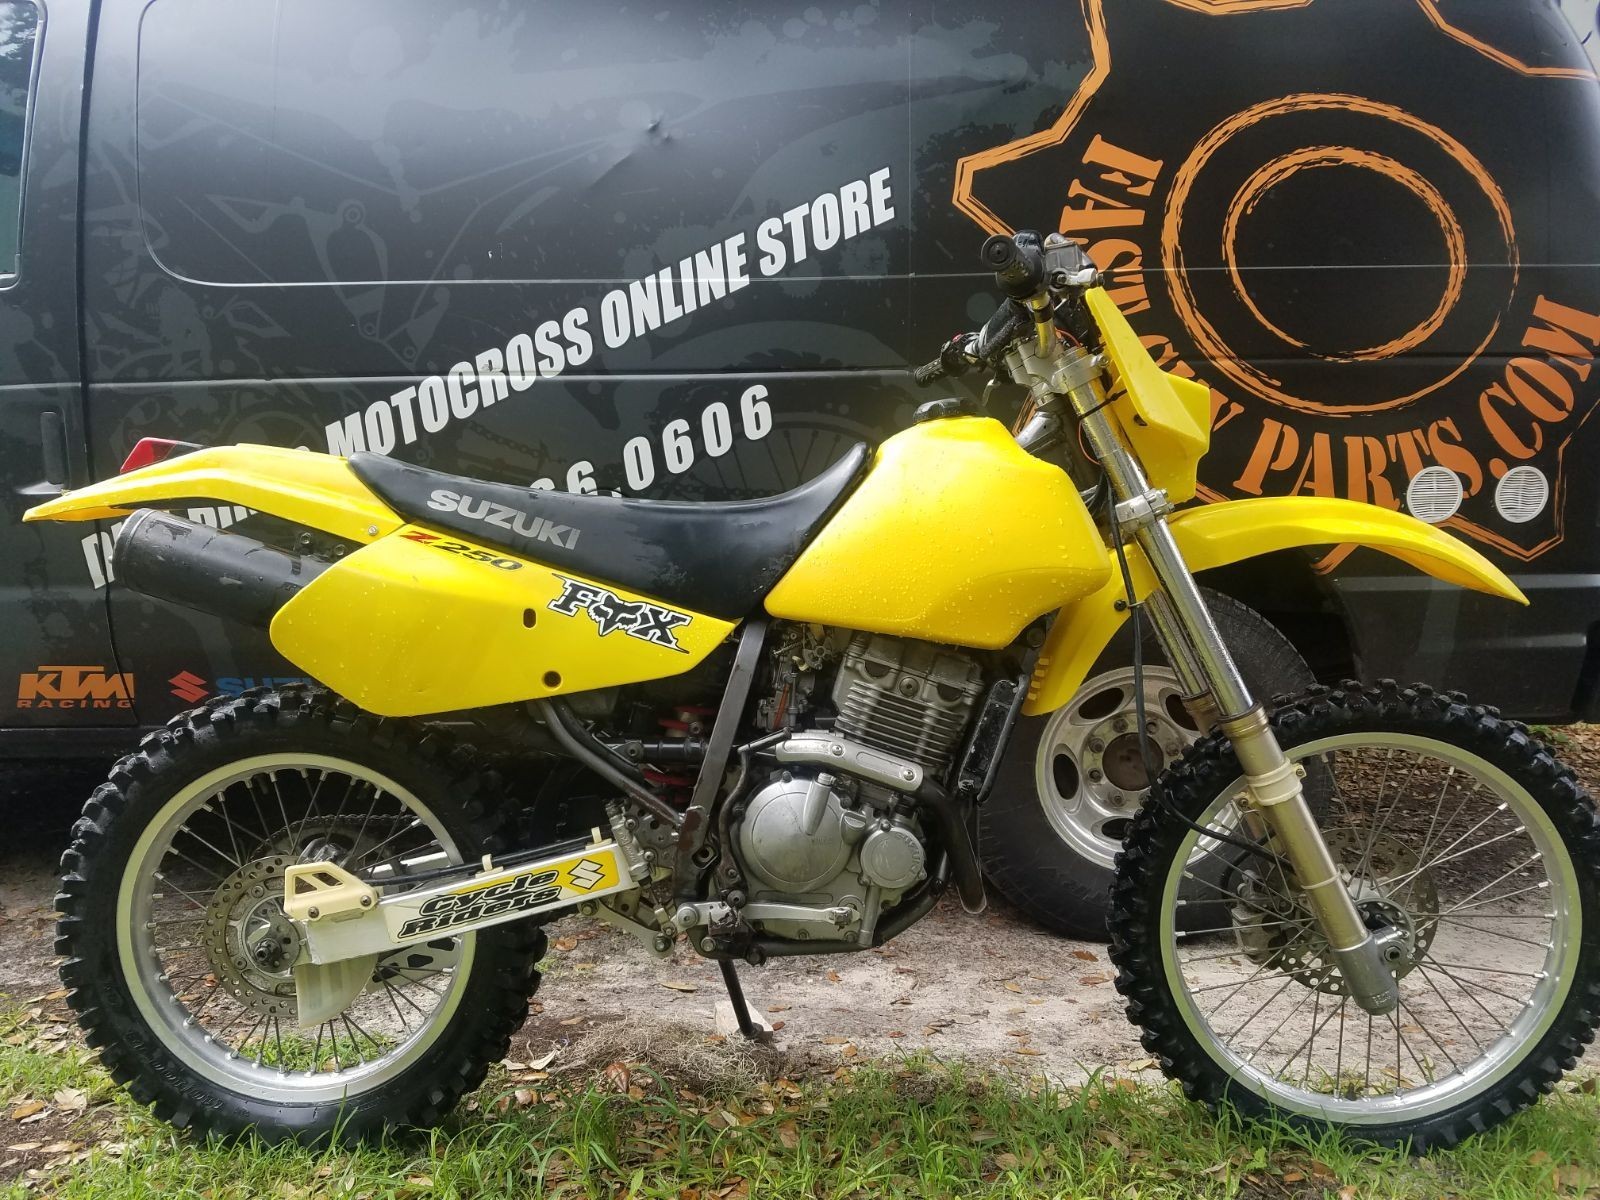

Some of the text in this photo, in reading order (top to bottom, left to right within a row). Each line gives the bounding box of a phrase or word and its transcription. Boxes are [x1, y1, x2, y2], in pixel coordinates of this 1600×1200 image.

[325, 166, 895, 459] MOTOCROSS ONLINE STORE
[426, 489, 581, 550] SUZUKI
[547, 572, 697, 654] FOX
[16, 700, 135, 708] RACING
[17, 665, 134, 699] KTM
[398, 885, 562, 939] Riders
[419, 869, 559, 917] Cycle
